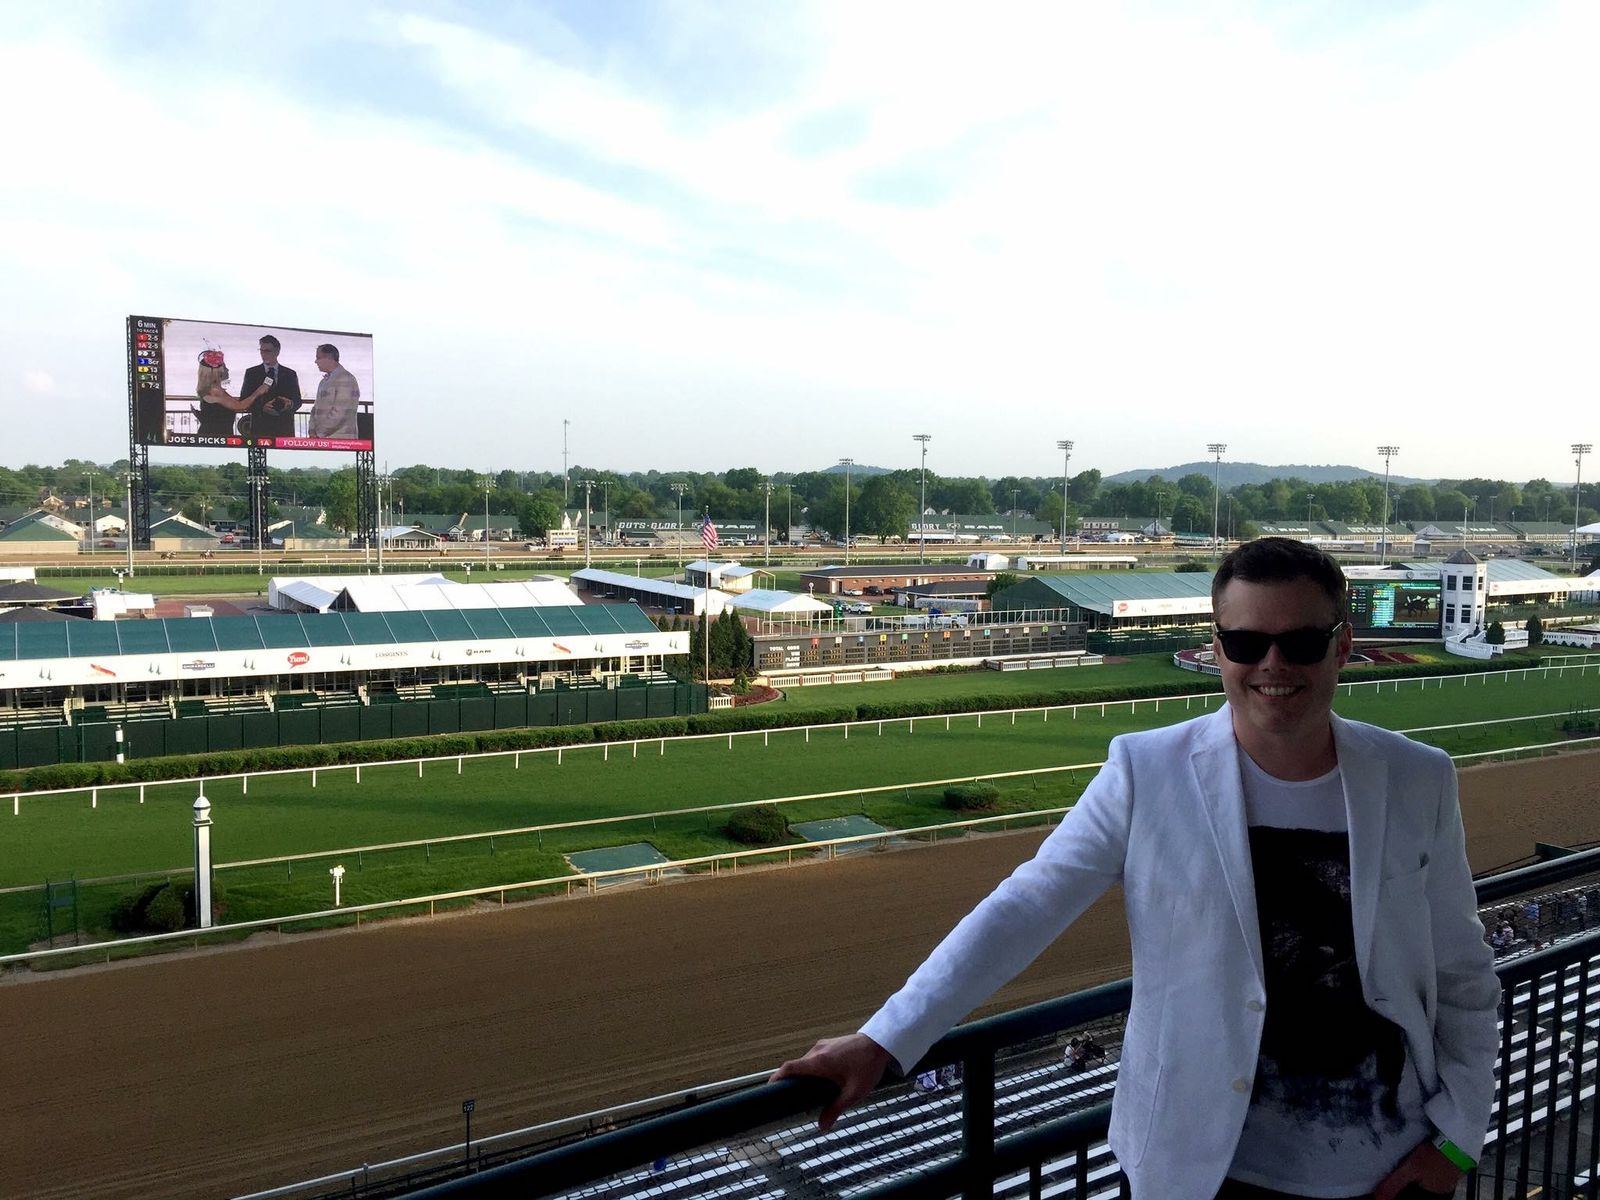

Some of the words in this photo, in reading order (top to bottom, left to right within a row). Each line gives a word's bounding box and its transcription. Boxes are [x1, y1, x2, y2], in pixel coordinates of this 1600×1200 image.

[137, 320, 143, 328] 6
[168, 436, 196, 444] JOE'S
[198, 437, 226, 445] PICKS
[260, 439, 271, 447] 1A
[283, 439, 316, 448] FOLLOW
[317, 440, 330, 448] US!
[289, 655, 309, 663] Yum!
